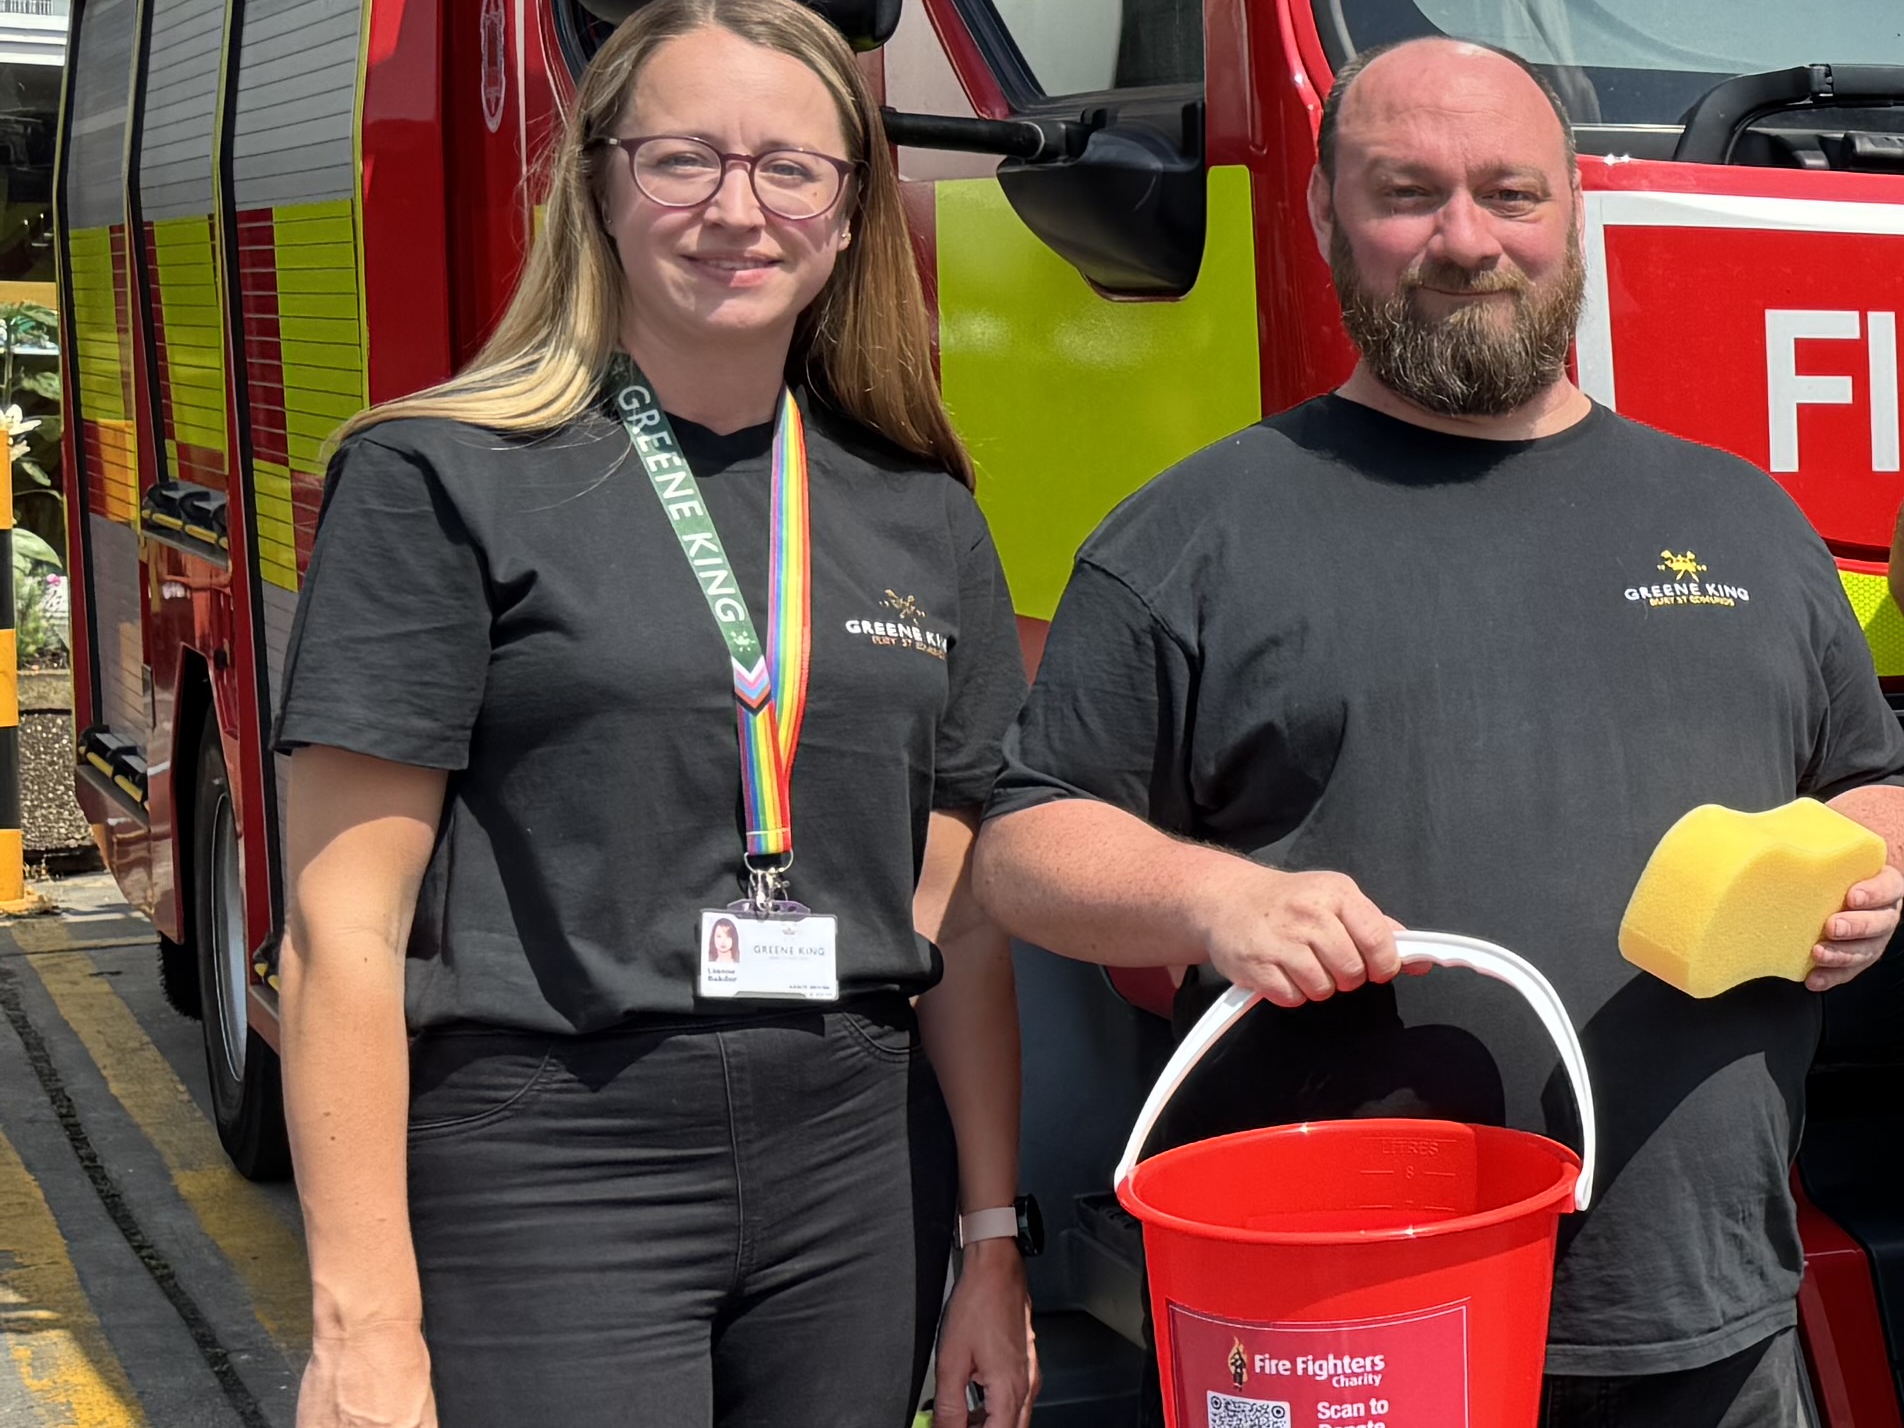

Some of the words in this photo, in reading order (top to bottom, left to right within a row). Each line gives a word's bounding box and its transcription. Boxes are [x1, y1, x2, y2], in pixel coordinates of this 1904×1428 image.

[617, 385, 704, 520] GREENE
[682, 532, 745, 623] KING
[1624, 583, 1700, 601] GREENE
[1705, 583, 1749, 601] KING
[845, 620, 922, 642] GREENE
[926, 632, 948, 653] KIN
[753, 945, 794, 956] GREENE
[798, 946, 826, 957] KING
[1254, 1354, 1291, 1375] Fire
[1297, 1354, 1385, 1380] Fighters
[1332, 1373, 1382, 1389] Charity
[1317, 1401, 1365, 1420] Scan
[1369, 1398, 1389, 1416] to
